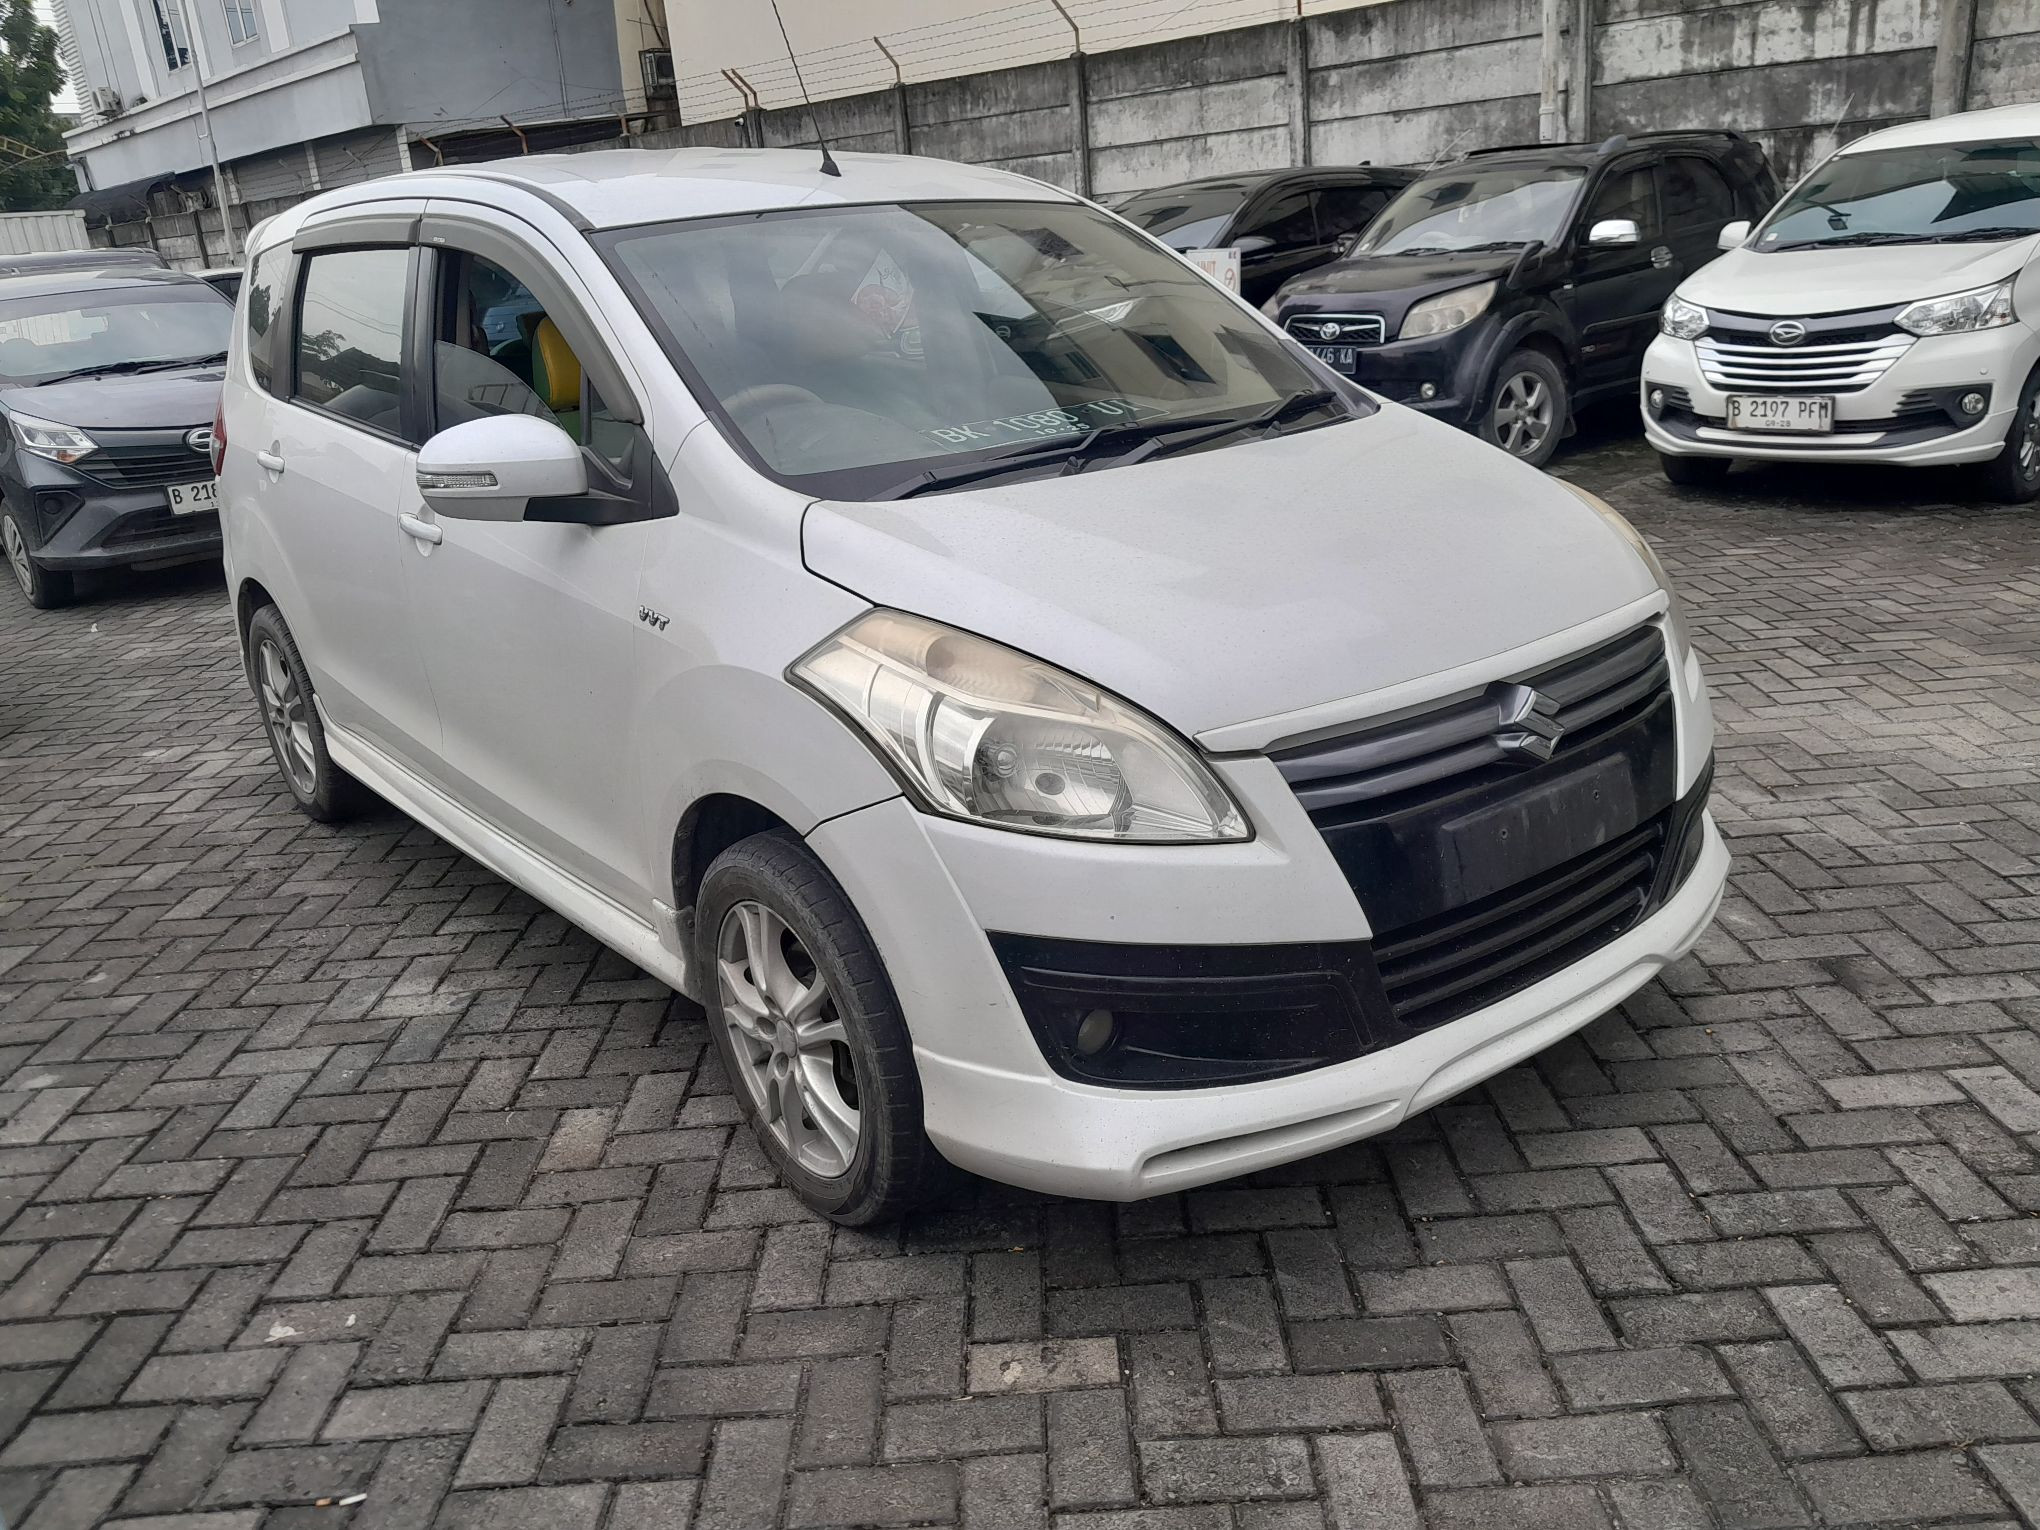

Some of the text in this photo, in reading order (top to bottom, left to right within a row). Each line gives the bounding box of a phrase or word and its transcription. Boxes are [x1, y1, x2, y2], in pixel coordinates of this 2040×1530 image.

[1732, 400, 1828, 419] B 2197 PFM
[930, 424, 991, 443] BK
[992, 409, 1080, 432] 1080
[172, 488, 183, 505] B
